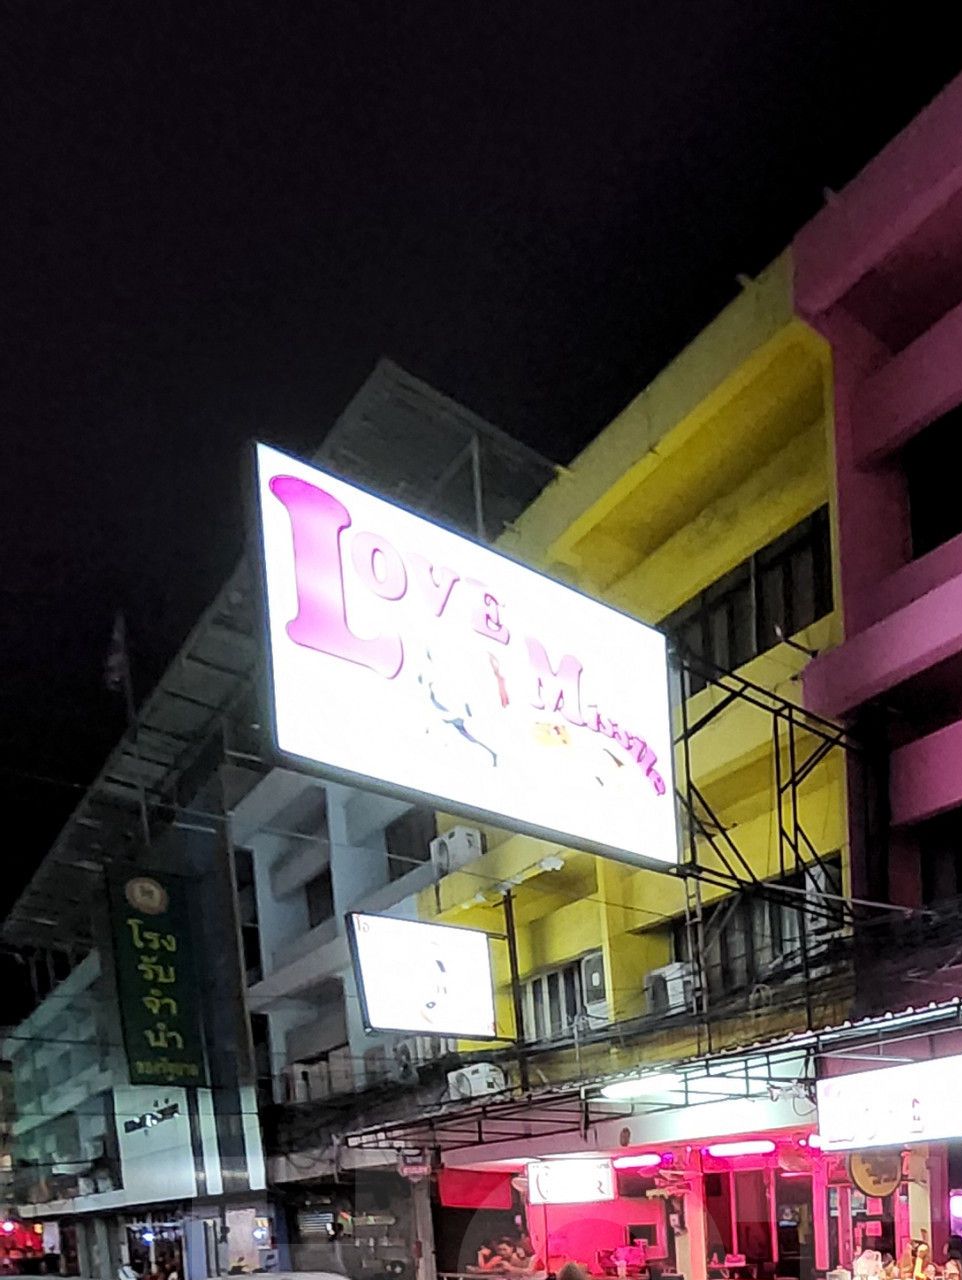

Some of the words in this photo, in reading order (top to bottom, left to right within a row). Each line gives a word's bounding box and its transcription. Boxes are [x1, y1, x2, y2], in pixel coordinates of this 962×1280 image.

[126, 918, 178, 953] โรง
[137, 954, 177, 985] รับ
[142, 987, 179, 1017] จำ
